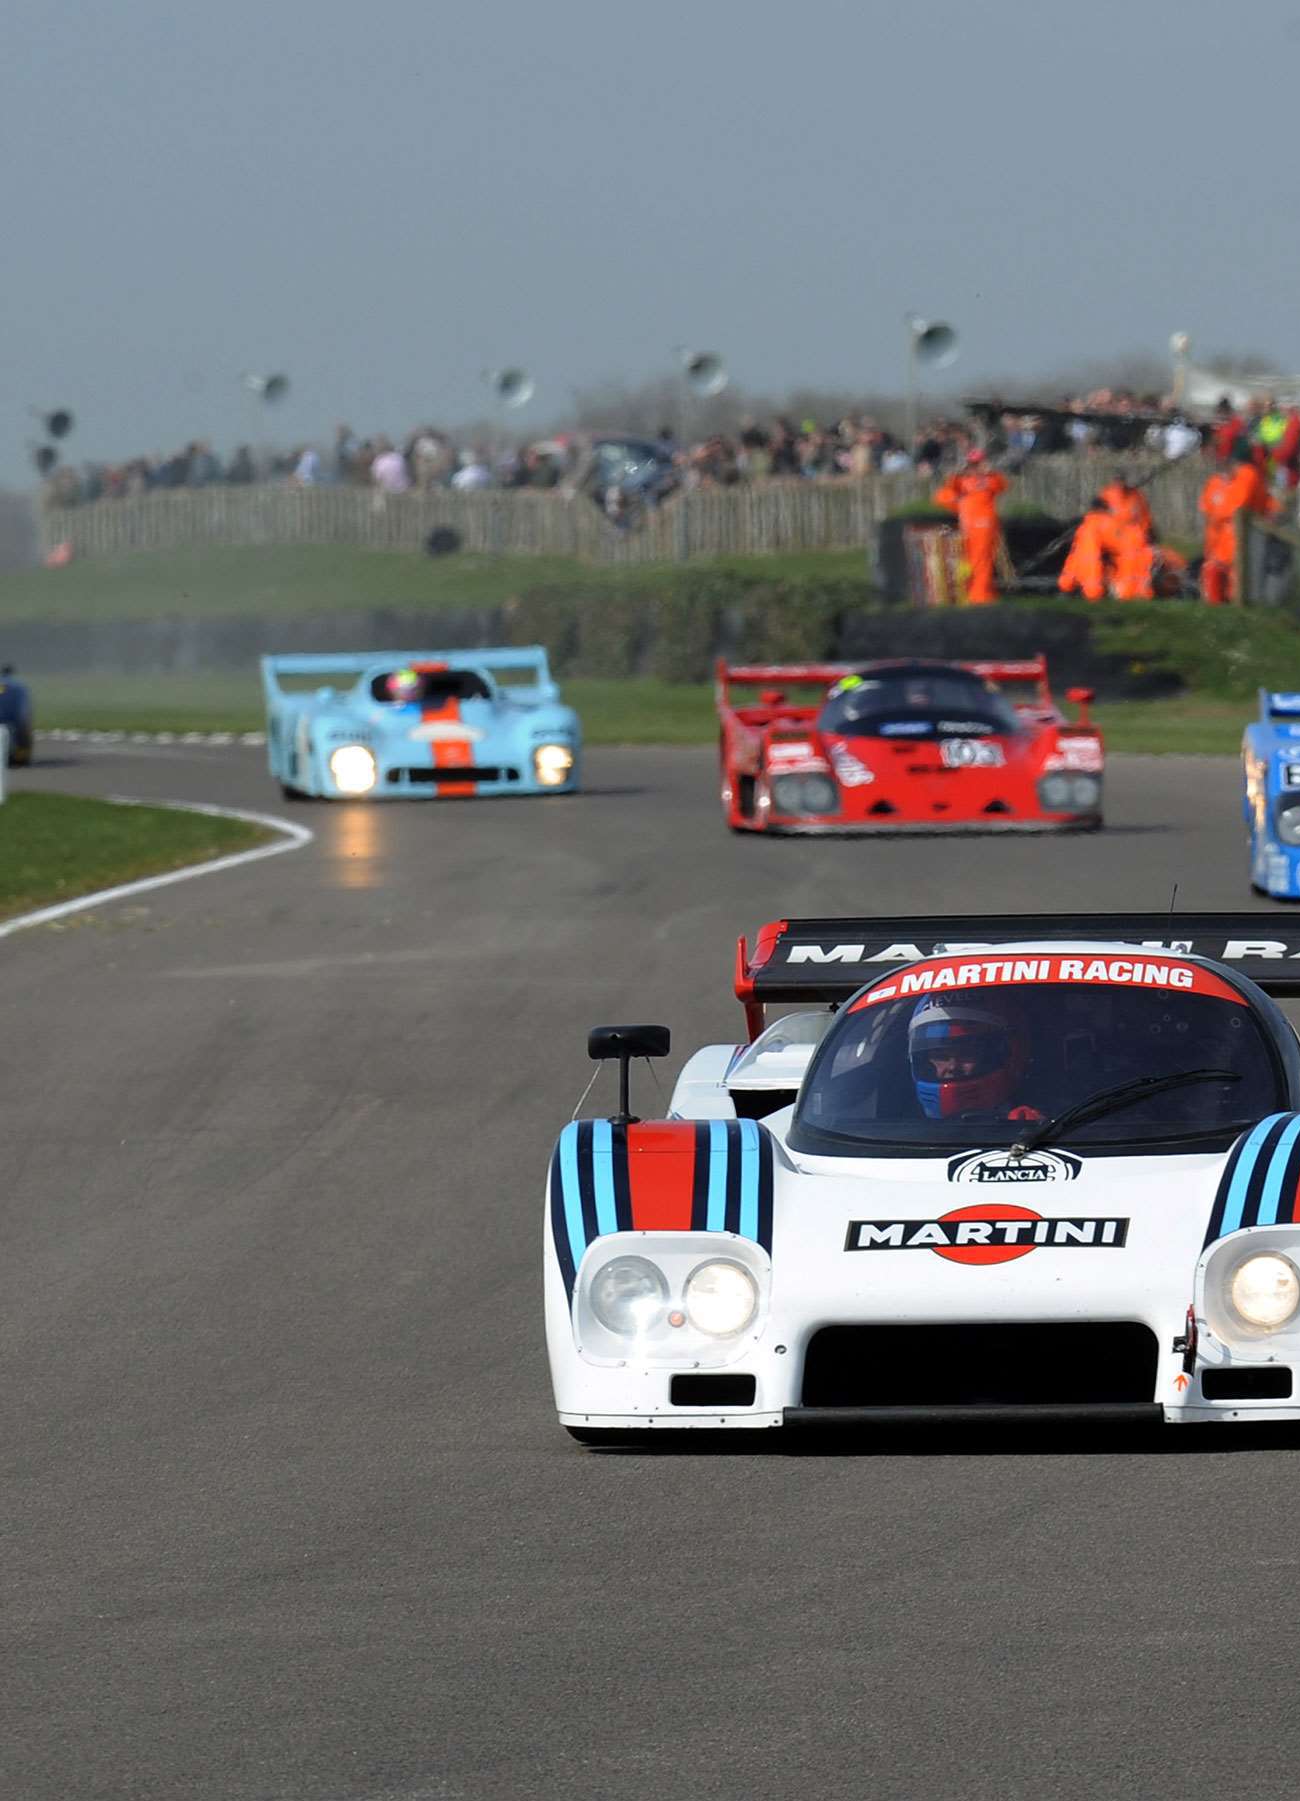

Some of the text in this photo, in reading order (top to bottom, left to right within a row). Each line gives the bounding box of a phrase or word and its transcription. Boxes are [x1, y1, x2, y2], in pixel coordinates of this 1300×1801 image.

[900, 959, 1194, 995] MARTINI RACING
[981, 1169, 1047, 1182] LANCIA
[858, 1220, 1118, 1248] MARTINI
